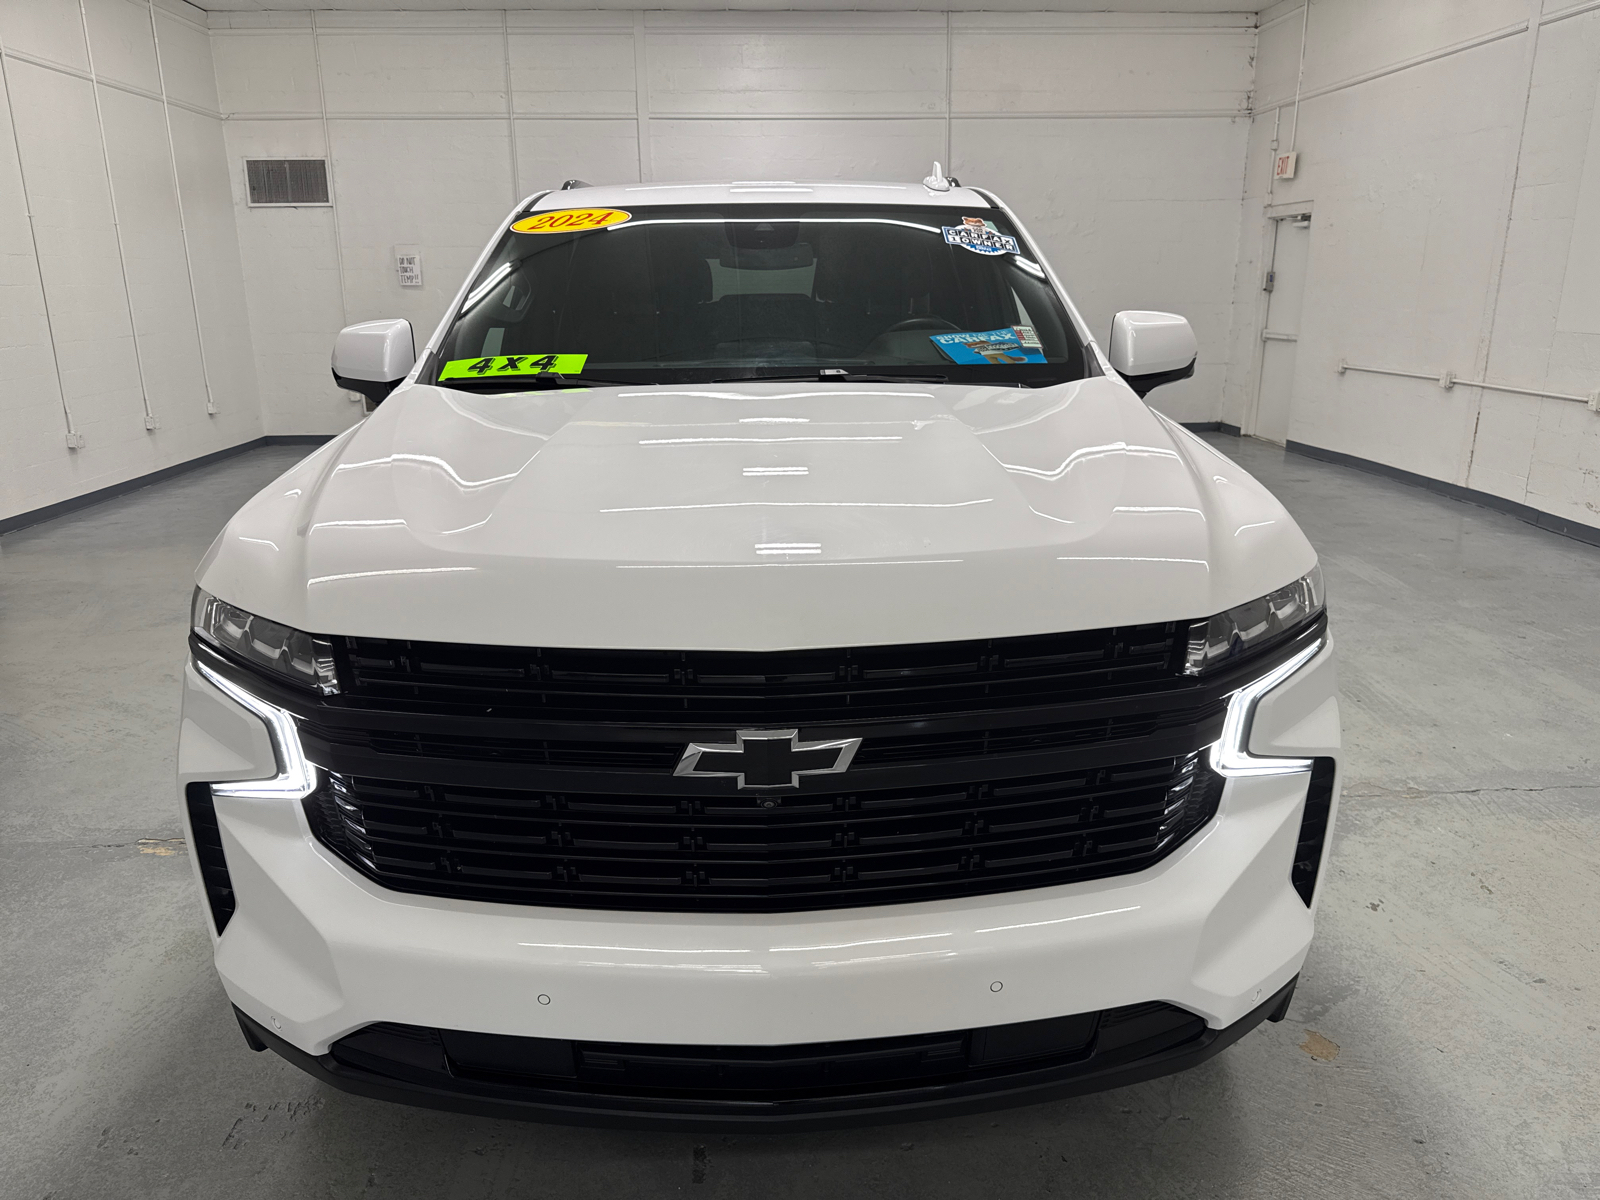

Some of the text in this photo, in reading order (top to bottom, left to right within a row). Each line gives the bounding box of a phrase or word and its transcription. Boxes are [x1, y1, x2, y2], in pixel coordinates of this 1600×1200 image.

[1276, 155, 1290, 176] EXIT
[526, 211, 615, 231] 2024
[947, 229, 1012, 245] CARFAX
[960, 237, 1014, 251] OWNER
[398, 256, 417, 266] DO NOT
[399, 266, 414, 274] TOUCH
[939, 333, 1017, 344] CARFAX
